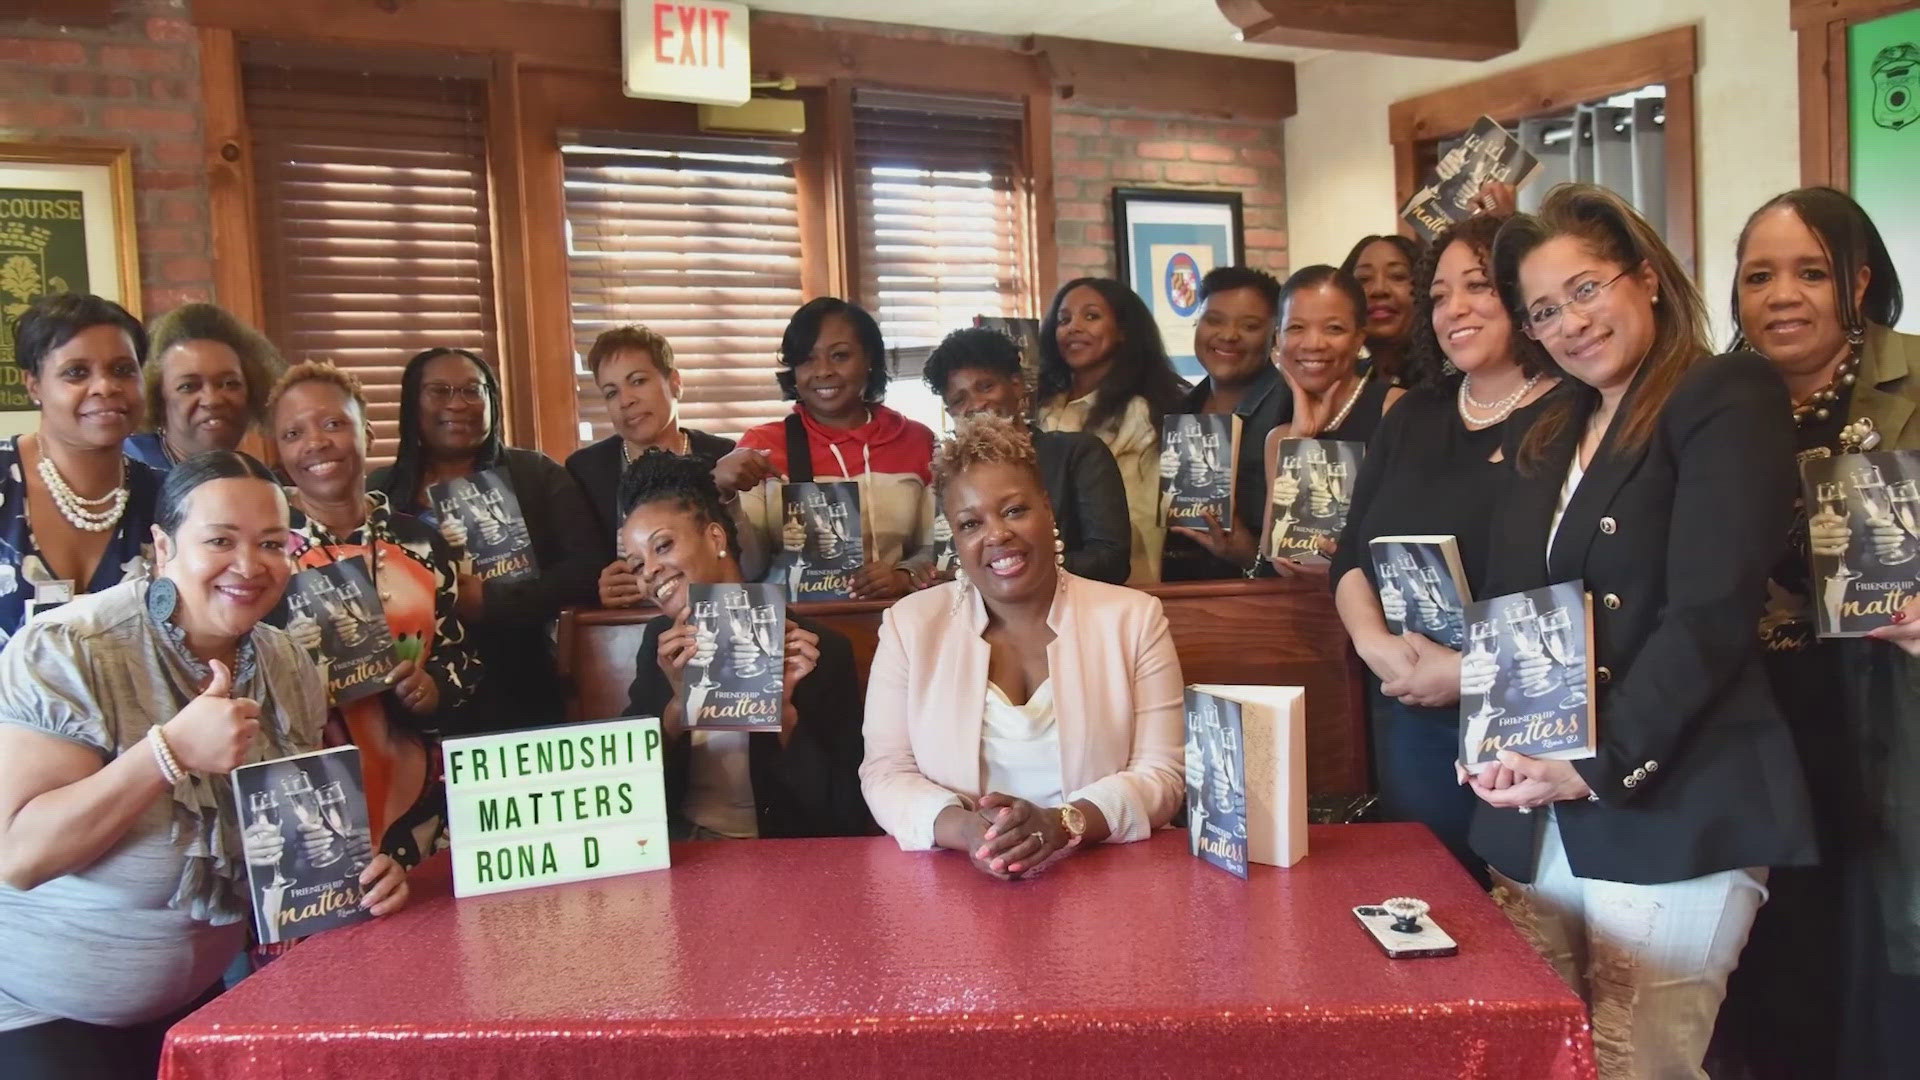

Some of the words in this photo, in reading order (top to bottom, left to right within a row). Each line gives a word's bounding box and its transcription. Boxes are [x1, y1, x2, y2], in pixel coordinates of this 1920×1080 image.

[654, 4, 730, 69] EXIT
[0, 198, 81, 219] COURSE
[1281, 533, 1320, 551] matt
[799, 574, 849, 593] matter
[1855, 581, 1914, 591] FRIENDSHIP
[1838, 588, 1914, 617] matte
[714, 691, 760, 699] FRIENDSHIP
[699, 697, 777, 719] matters
[1499, 711, 1555, 727] FRIENDSHIP
[1478, 713, 1579, 752] matters
[450, 729, 660, 785] FRIENDSHIP
[479, 783, 633, 833] MATTERS
[476, 842, 558, 883] RONA
[584, 836, 600, 869] D
[1200, 835, 1243, 864] matters
